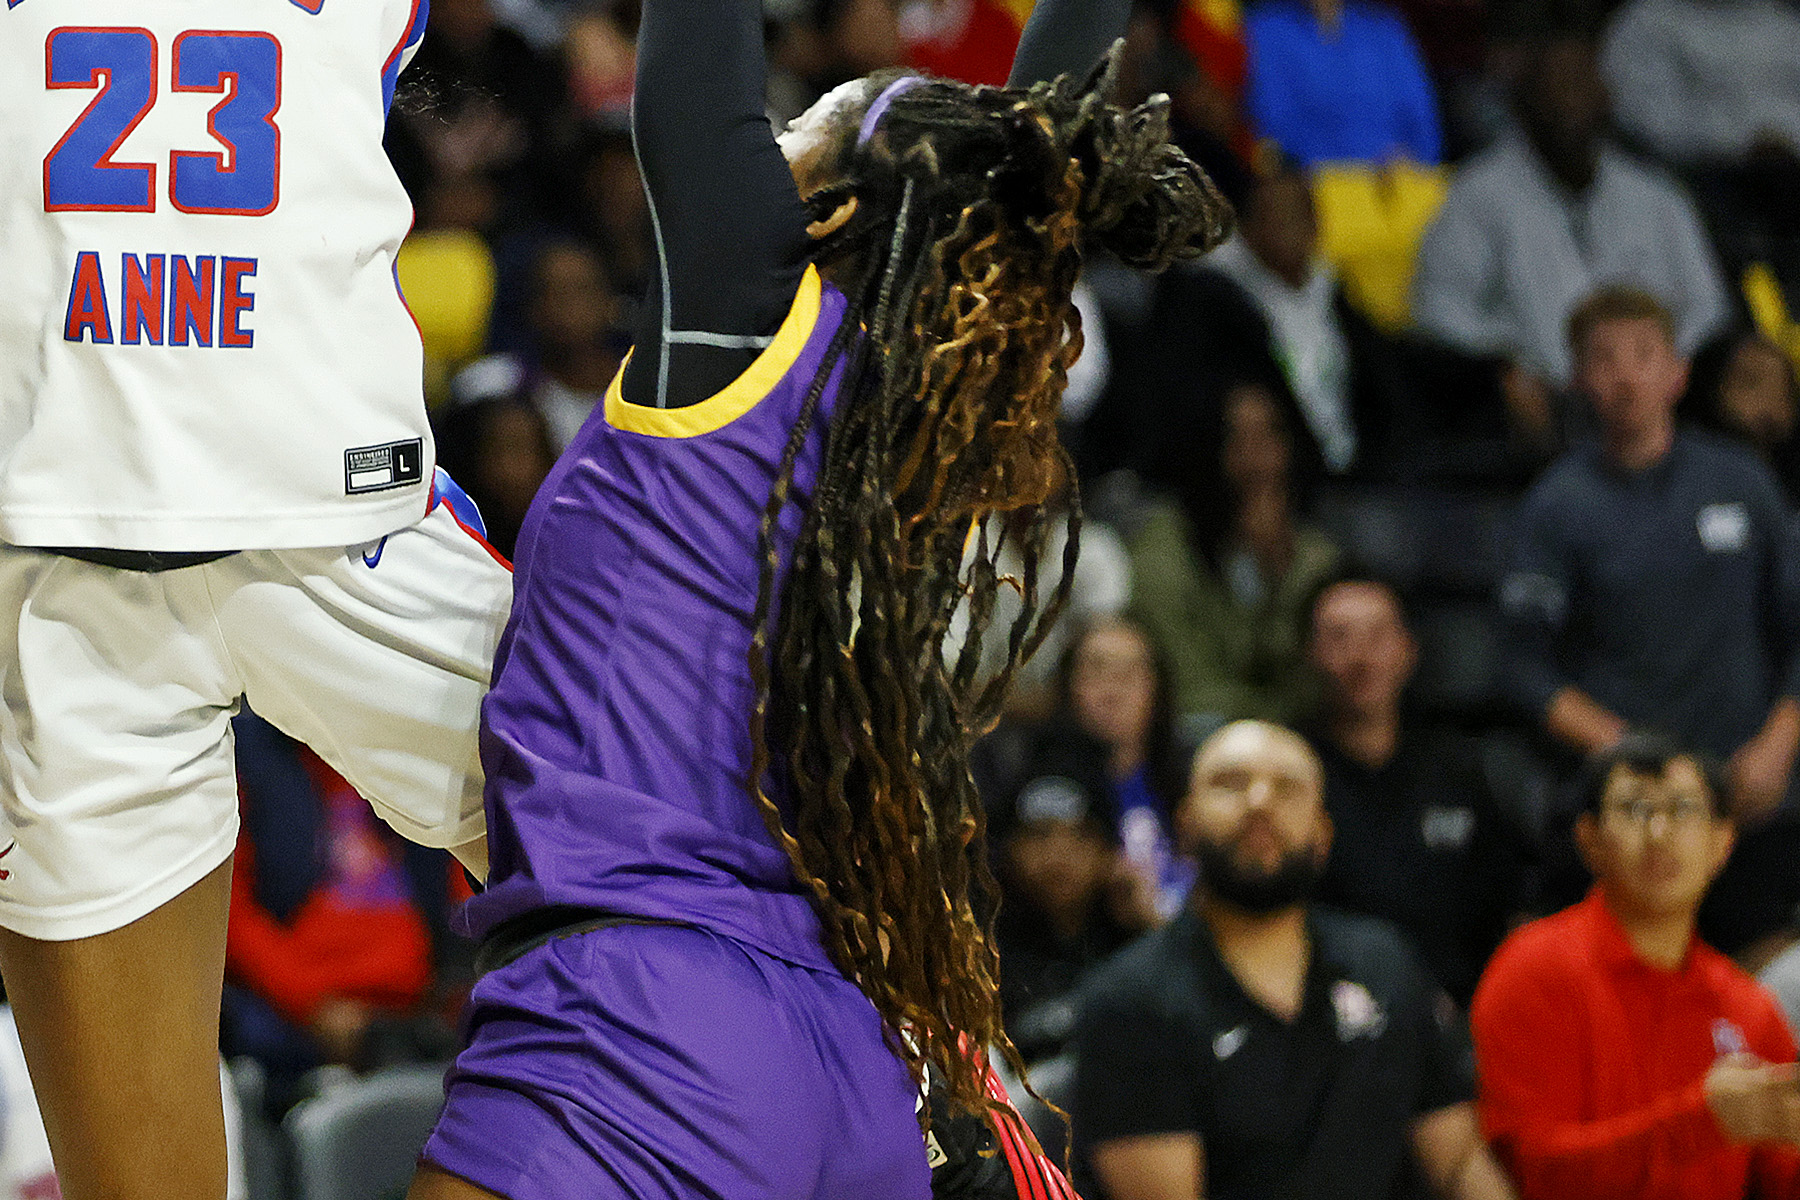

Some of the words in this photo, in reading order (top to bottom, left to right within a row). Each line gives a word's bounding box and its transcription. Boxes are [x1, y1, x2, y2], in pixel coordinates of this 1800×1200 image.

[42, 26, 283, 217] 23
[63, 250, 259, 349] ANNE
[399, 454, 411, 473] L
